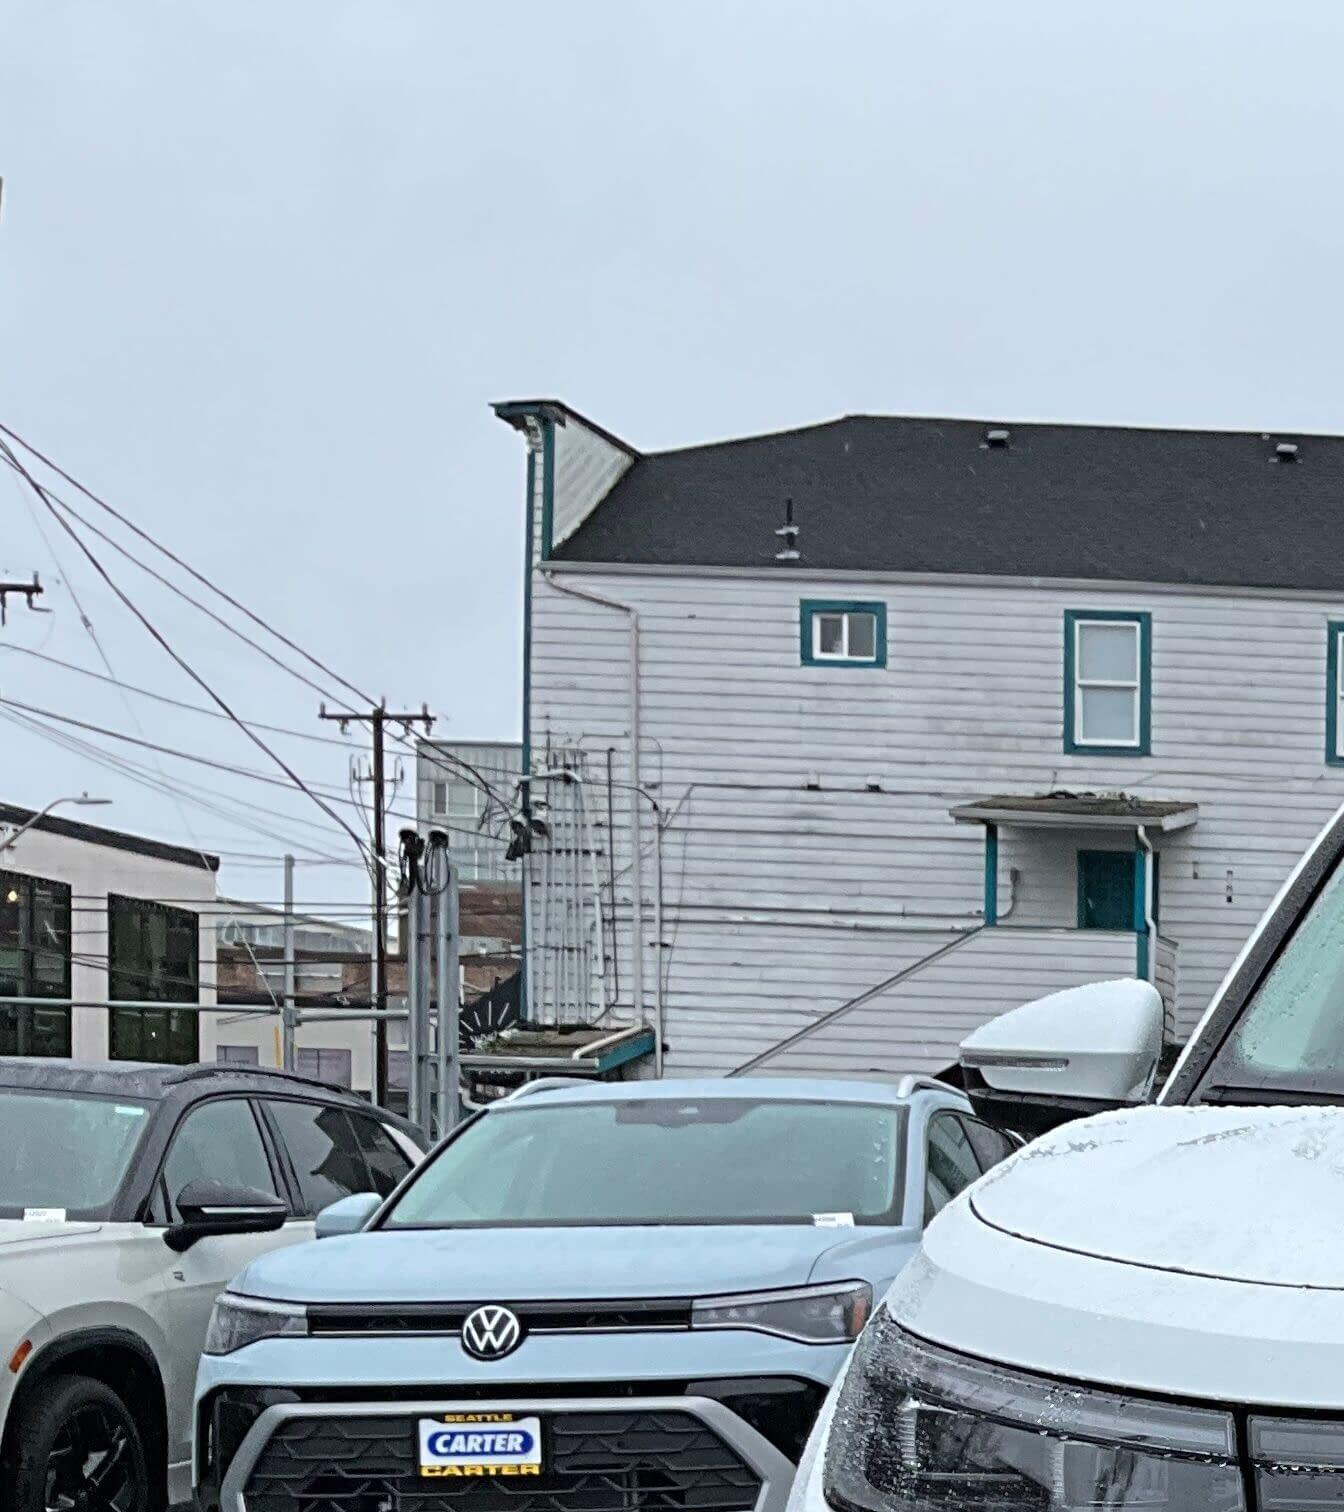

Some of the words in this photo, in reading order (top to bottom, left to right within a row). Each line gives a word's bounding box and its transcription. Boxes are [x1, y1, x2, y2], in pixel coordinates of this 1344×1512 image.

[444, 1413, 513, 1422] SEATTLE
[435, 1433, 524, 1454] CARTER
[421, 1464, 540, 1477] CARTER
